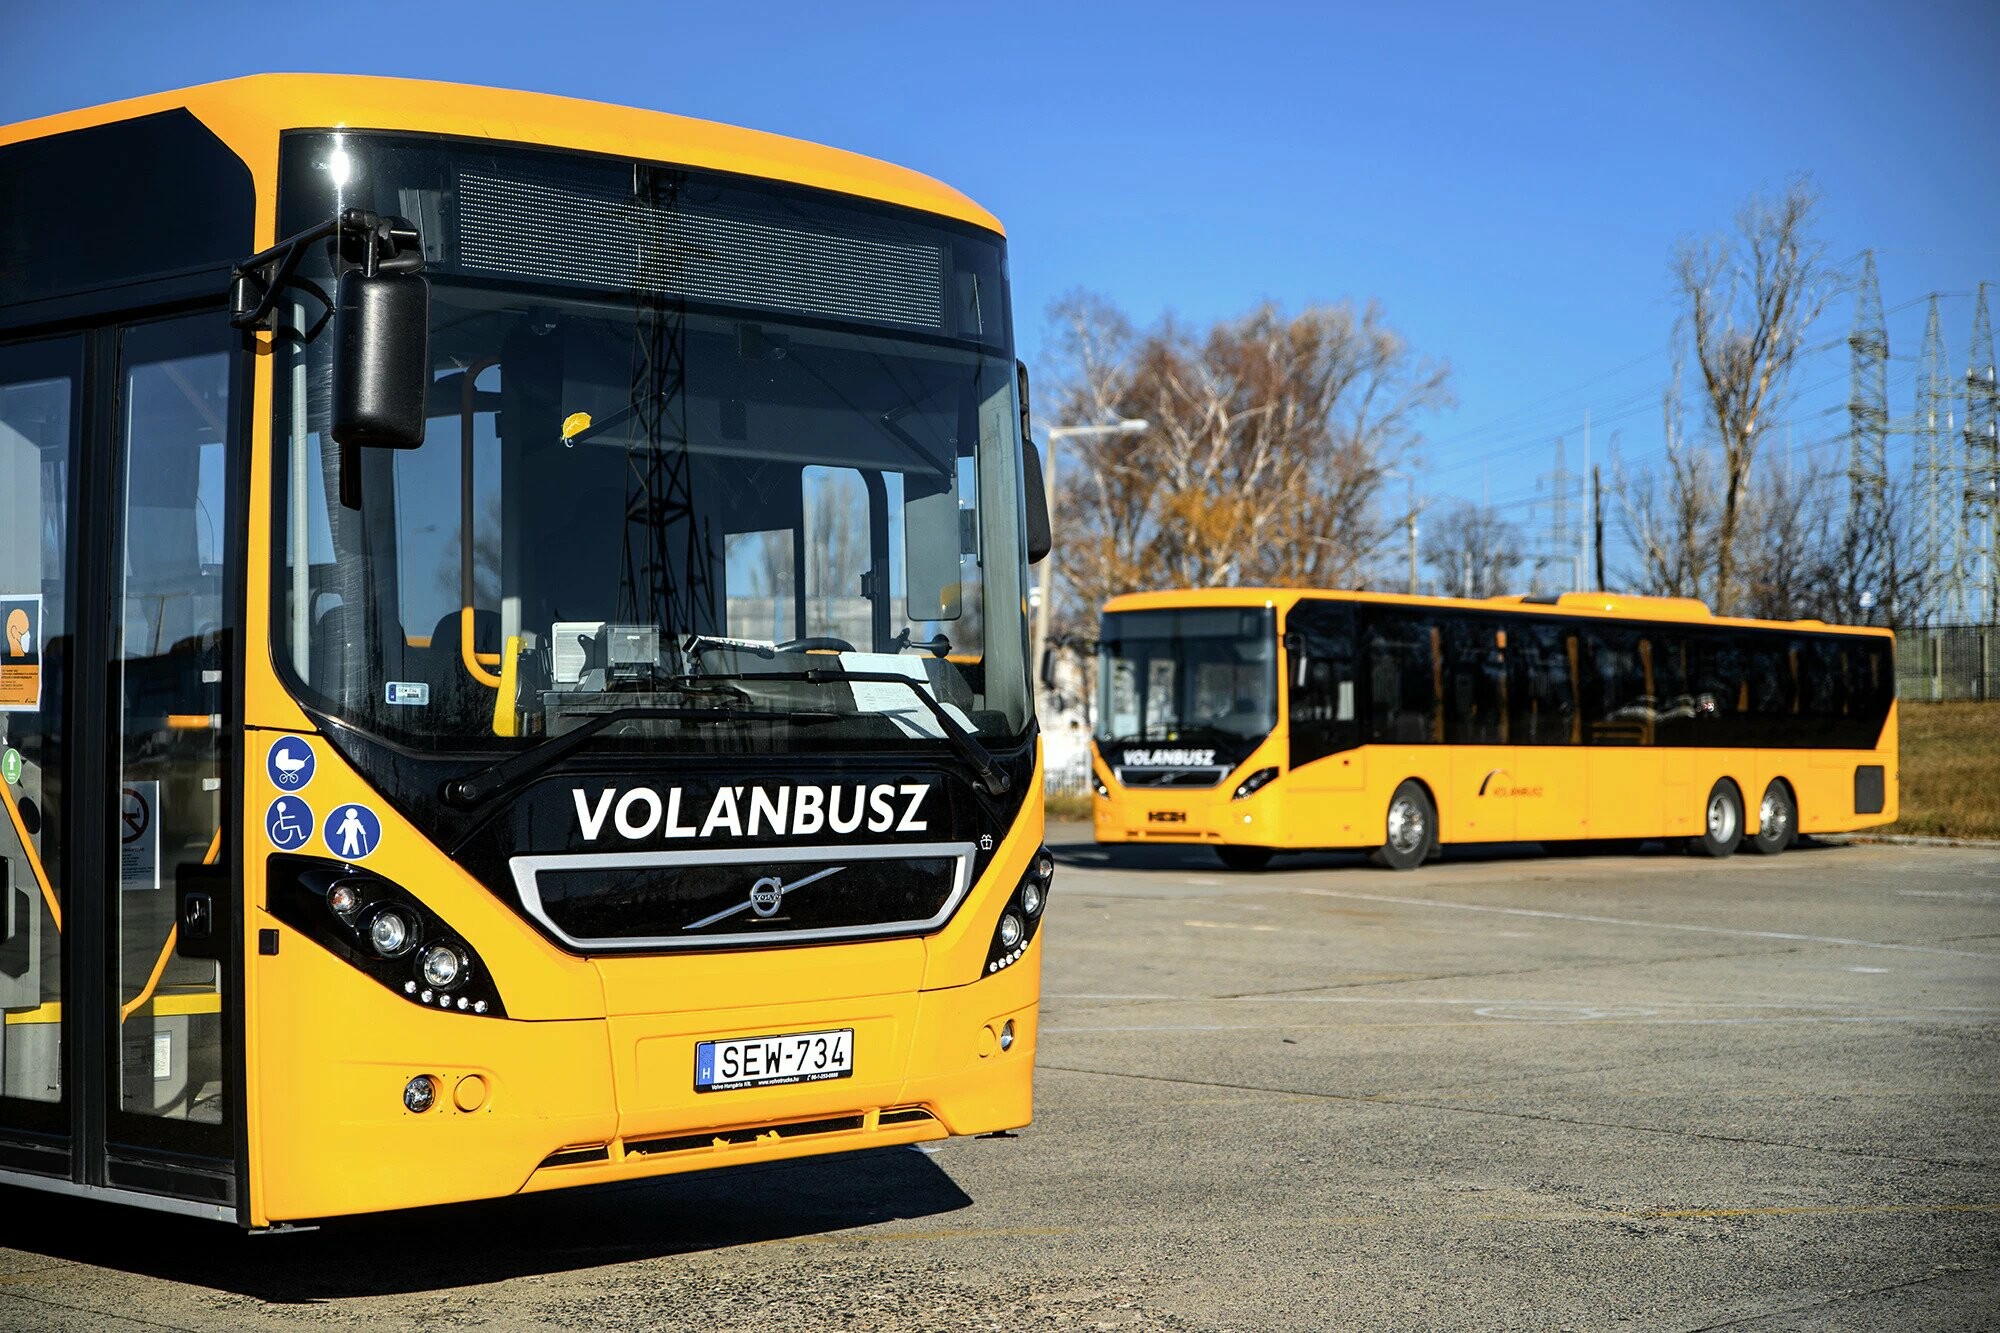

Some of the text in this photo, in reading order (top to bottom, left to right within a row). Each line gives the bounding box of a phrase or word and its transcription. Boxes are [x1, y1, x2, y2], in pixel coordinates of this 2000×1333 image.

[572, 784, 930, 841] VOLÁNBUSZ
[753, 893, 780, 901] VOLVO
[722, 1036, 844, 1078] SEW-734
[702, 1067, 711, 1079] H
